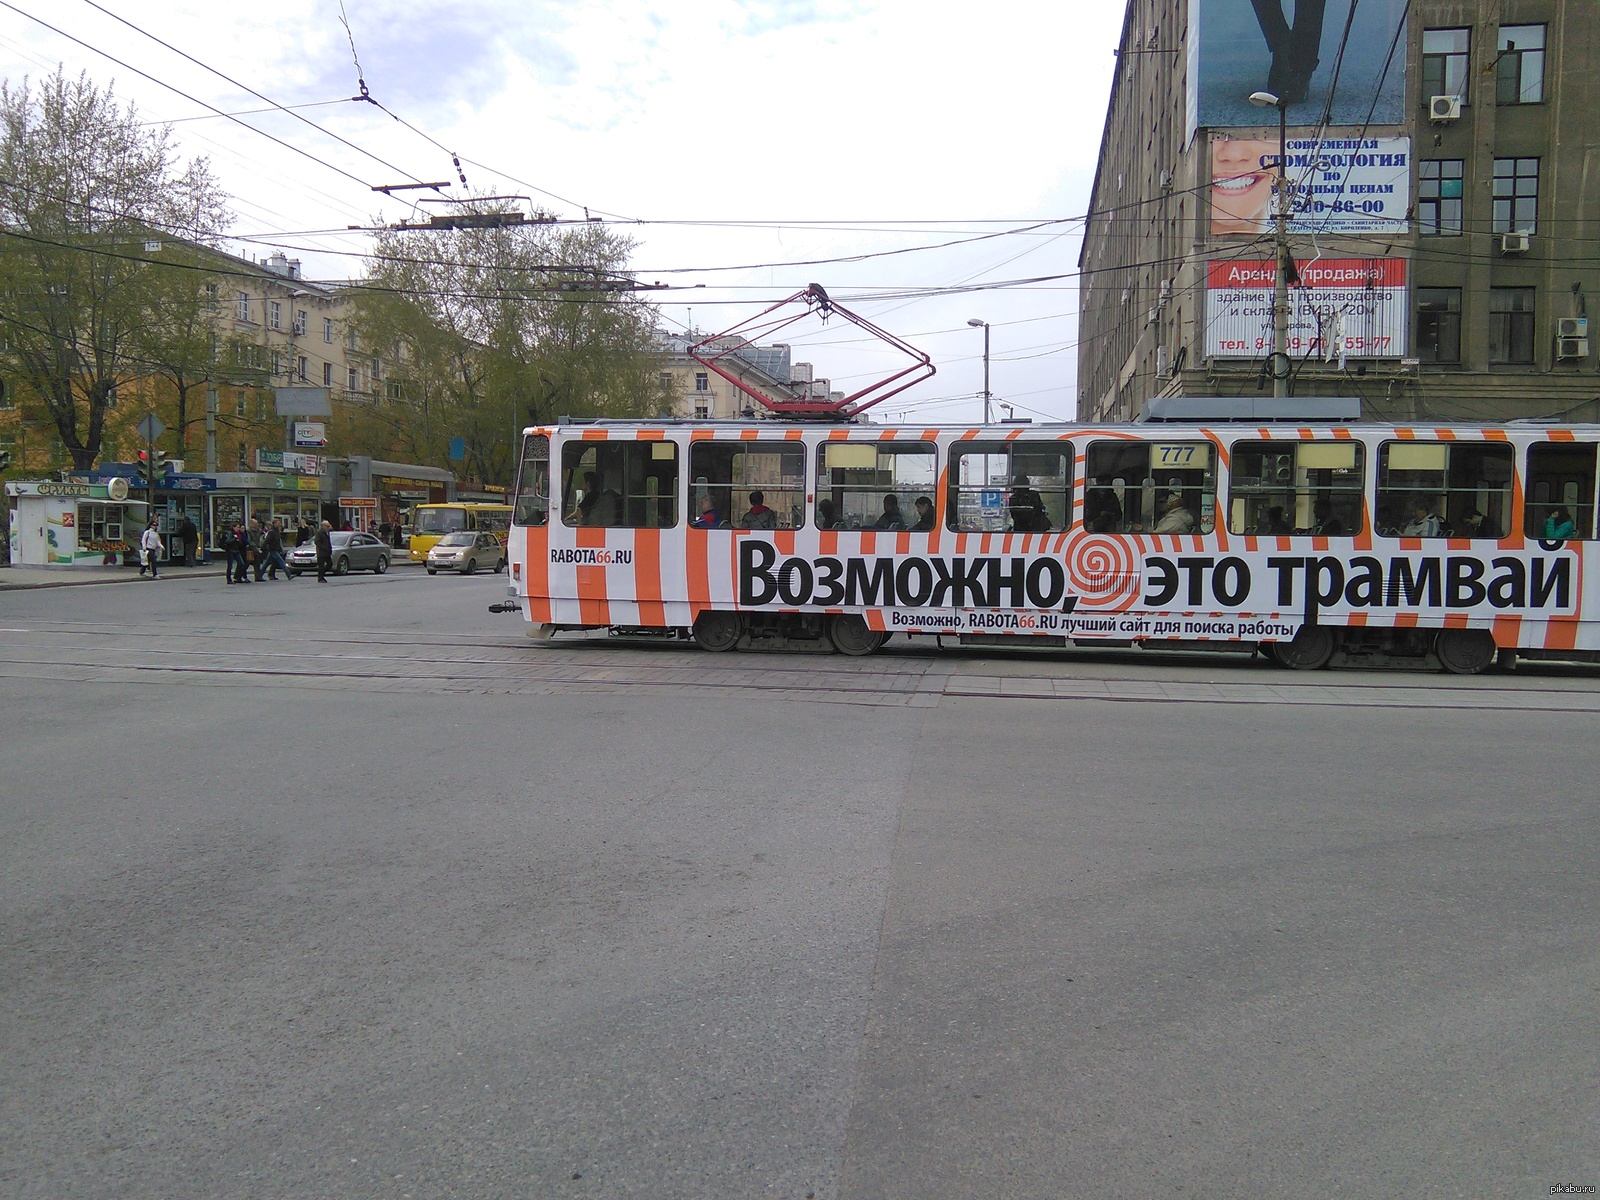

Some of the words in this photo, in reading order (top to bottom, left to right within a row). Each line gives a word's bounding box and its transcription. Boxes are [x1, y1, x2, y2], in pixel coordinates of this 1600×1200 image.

[1286, 140, 1378, 150] СОВРЕМЕННАЯ
[1259, 154, 1406, 167] СТОМАТОЛОГИЯ
[1323, 171, 1341, 181] ПО
[1271, 184, 1345, 194] ВГОДНЫМ
[1350, 184, 1394, 195] ЦЕНАМ
[1300, 266, 1385, 283] (продажа)
[1217, 292, 1265, 303] здание
[1269, 292, 1294, 303] пд
[1300, 292, 1393, 303] производство
[1230, 307, 1239, 315] и
[1219, 339, 1249, 350] тел.
[1160, 446, 1195, 462] 777
[37, 484, 90, 496] ФРУКТЫ
[551, 549, 632, 564] RABOTA66.RU
[739, 539, 1079, 613] Возможно,
[1143, 556, 1251, 607] это
[1267, 539, 1571, 626] трамвай
[892, 611, 965, 628] Возможно,
[969, 613, 1058, 629] RABOTA66.RU
[1060, 616, 1116, 633] лучший
[1119, 617, 1151, 633] сайт
[1153, 621, 1180, 635] для
[1184, 622, 1234, 634] поиска
[1238, 620, 1294, 638] работы
